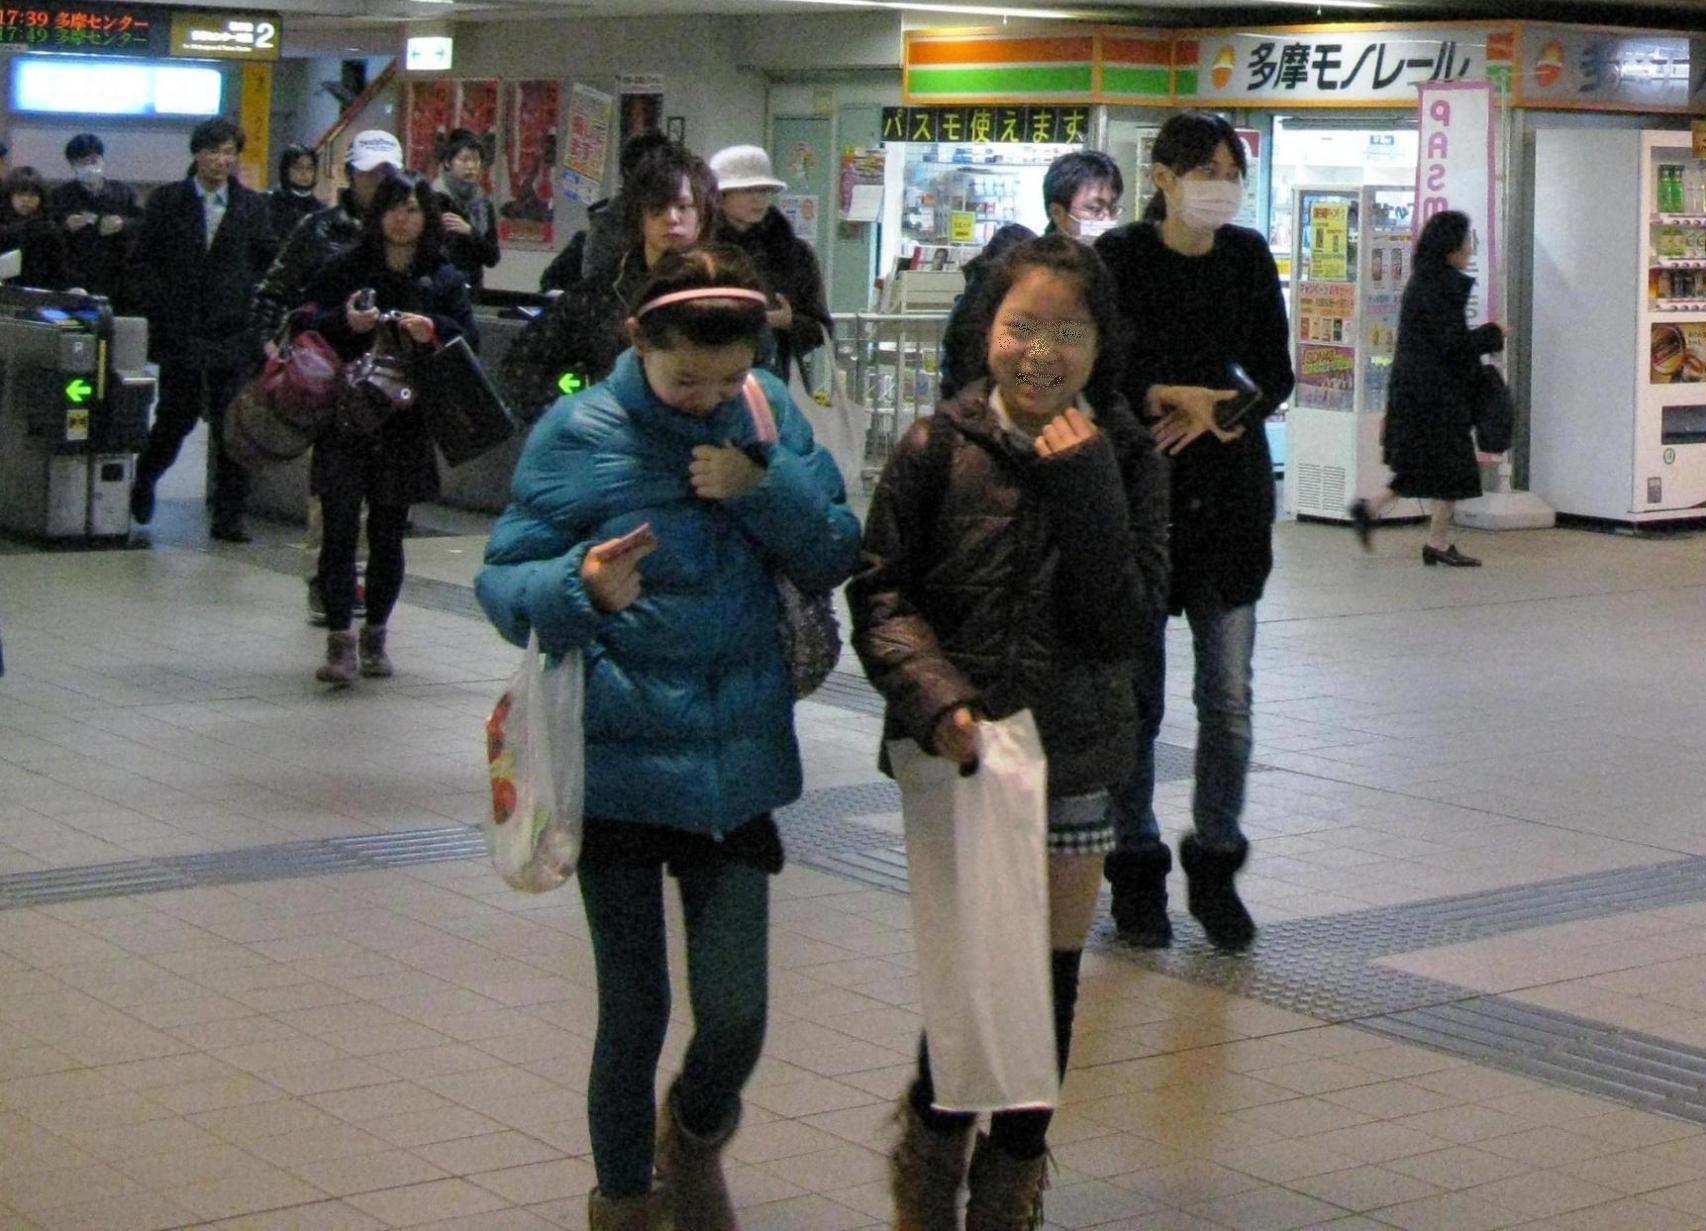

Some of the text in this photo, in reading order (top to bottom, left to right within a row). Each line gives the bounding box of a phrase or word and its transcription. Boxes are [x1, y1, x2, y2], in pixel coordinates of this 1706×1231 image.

[56, 11, 149, 31] 多摩センター
[256, 22, 275, 48] 2
[1247, 41, 1470, 90] 多摩モノレール
[884, 109, 1084, 144] パスモ使えます
